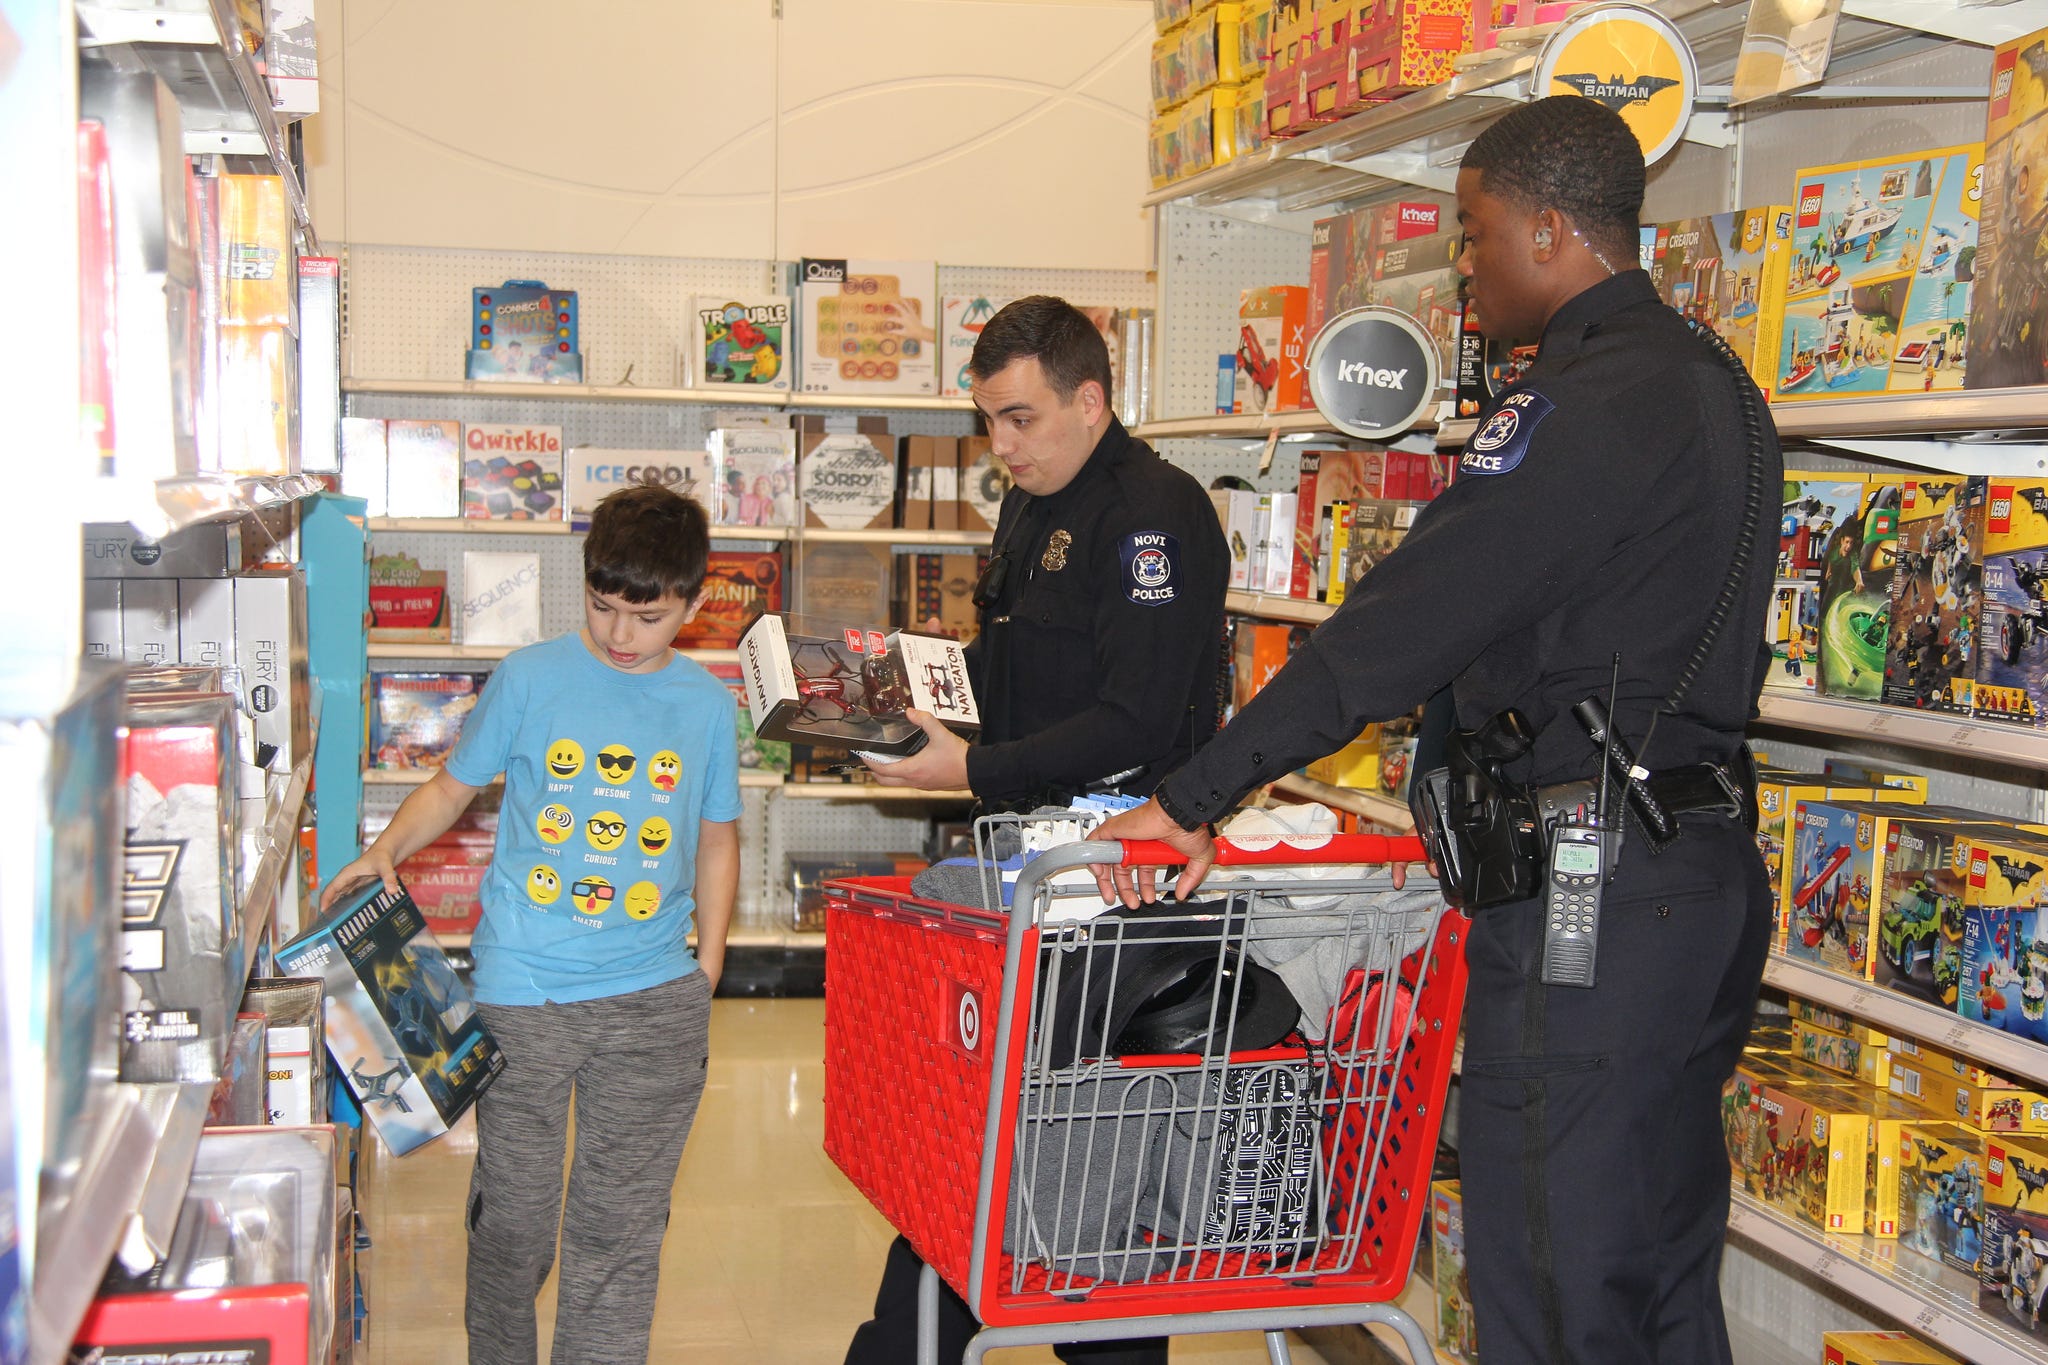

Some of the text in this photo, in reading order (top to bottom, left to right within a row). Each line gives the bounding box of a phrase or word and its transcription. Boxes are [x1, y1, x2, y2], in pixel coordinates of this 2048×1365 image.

[1584, 85, 1649, 99] BATMAN
[1801, 196, 1820, 215] LEGO
[1669, 231, 1700, 249] CREATOR
[807, 262, 844, 278] Otrio
[497, 296, 551, 315] CONNECT 4
[700, 303, 788, 326] TROUBLE
[1467, 313, 1479, 322] LEG
[495, 313, 556, 335] SHOTS
[1285, 324, 1305, 380] VEX
[1463, 340, 1480, 349] 9-16
[1503, 393, 1535, 408] NOVI
[467, 428, 560, 453] Qwirkle
[814, 472, 874, 487] SORRY
[1991, 499, 2011, 519] LEGO
[1134, 534, 1167, 547] NOVI
[1984, 571, 2003, 589] 8-14
[462, 563, 538, 618] SEQUENCE
[1132, 587, 1175, 600] POLICE
[255, 640, 272, 682] FURY
[747, 636, 768, 713] NAVIGATOR
[946, 646, 972, 715] NAVIGATOR
[548, 783, 575, 793] HAPPY
[593, 787, 631, 800] AWESOME
[651, 793, 670, 804] TIRED
[1805, 813, 1829, 828] CREATOR
[1900, 834, 1924, 851] CREATOR
[584, 853, 618, 866] CURIOUS
[642, 859, 659, 870] WOW
[1971, 861, 1987, 877] LEGO
[2002, 865, 2030, 882] BATMAN
[401, 873, 478, 886] SCRABBLE
[336, 903, 380, 946] SHARPER
[572, 914, 603, 929] AMAZED
[1965, 921, 1980, 938] 7-14
[288, 943, 332, 971] SHARPER
[300, 955, 330, 974] IMAGE
[159, 1011, 189, 1024] FULL
[152, 1023, 199, 1038] FUNCTION
[1760, 1097, 1784, 1117] CREATOR
[1988, 1157, 2003, 1173] LEGO
[2017, 1168, 2045, 1188] BATMAN
[1984, 1213, 1998, 1232] 8-14
